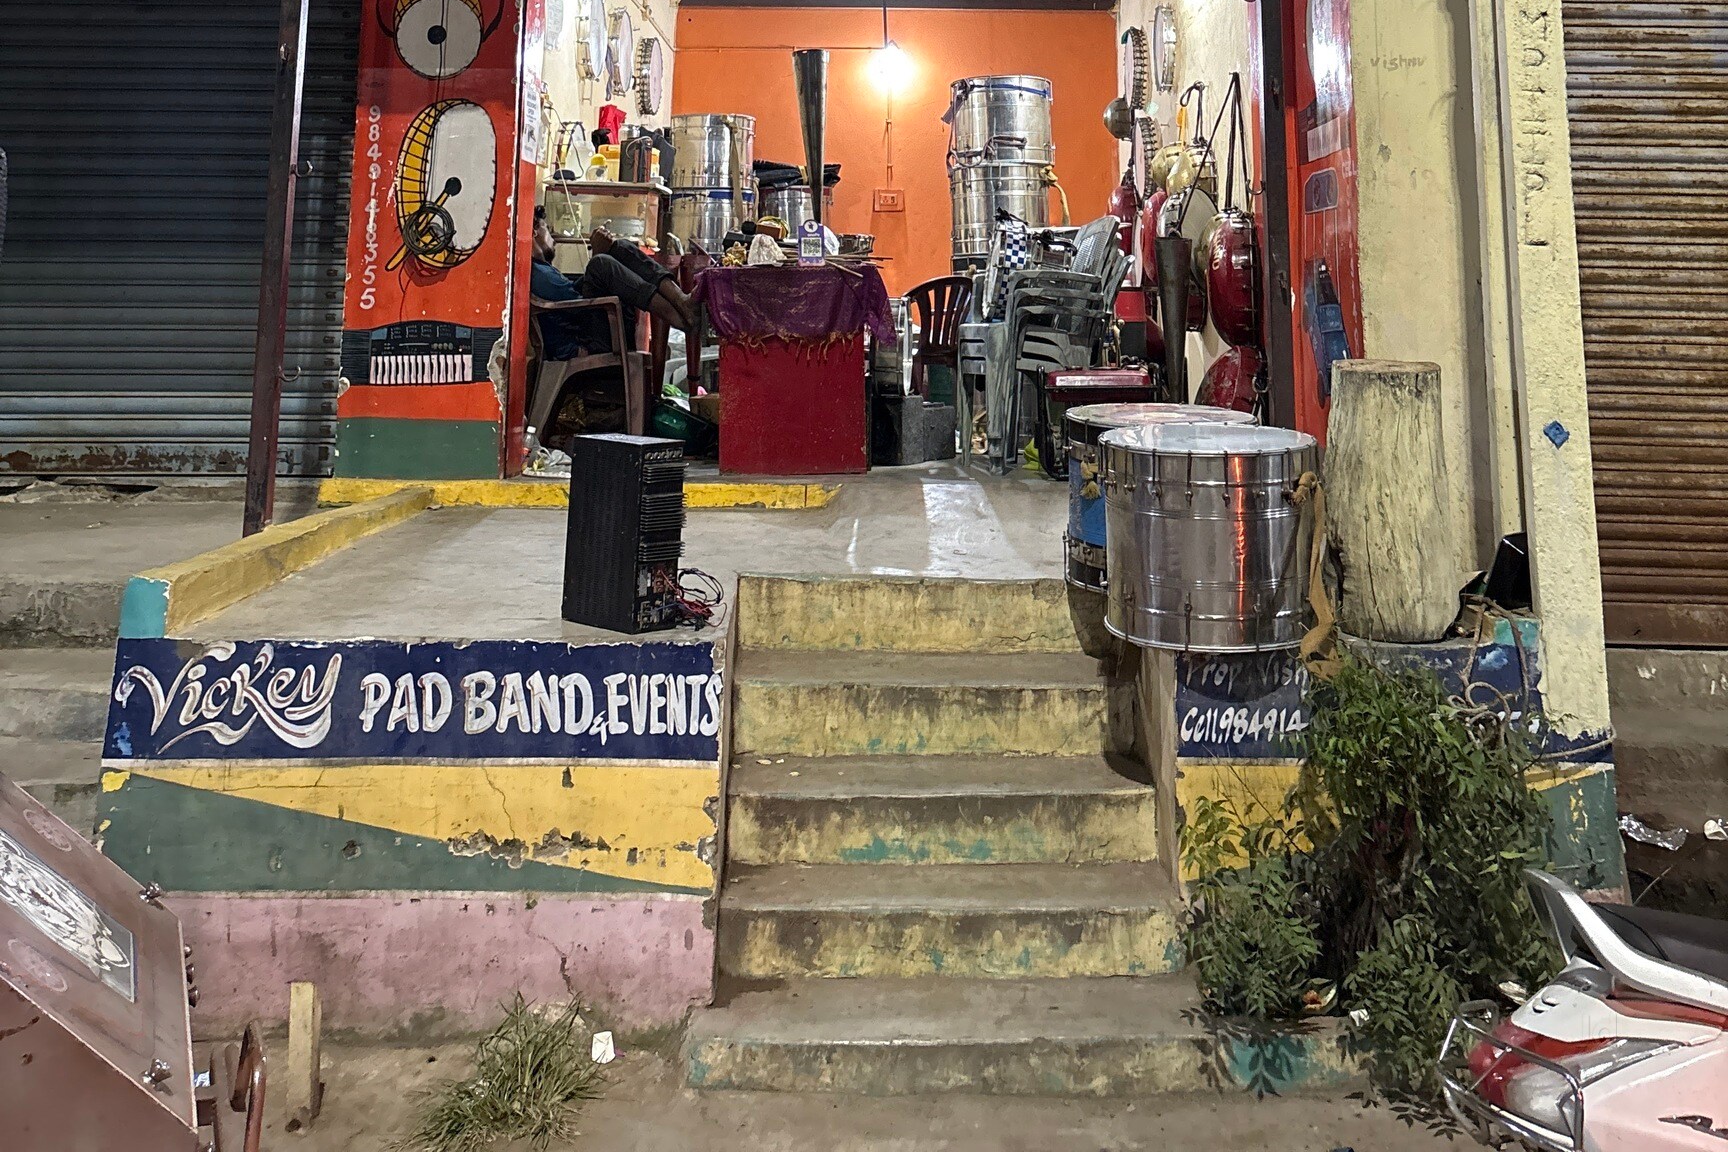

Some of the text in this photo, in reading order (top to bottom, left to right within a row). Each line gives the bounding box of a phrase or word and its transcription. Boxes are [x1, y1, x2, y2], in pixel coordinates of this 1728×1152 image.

[360, 672, 453, 733] PAD
[464, 671, 593, 735] BAND
[603, 673, 724, 736] EVENTS
